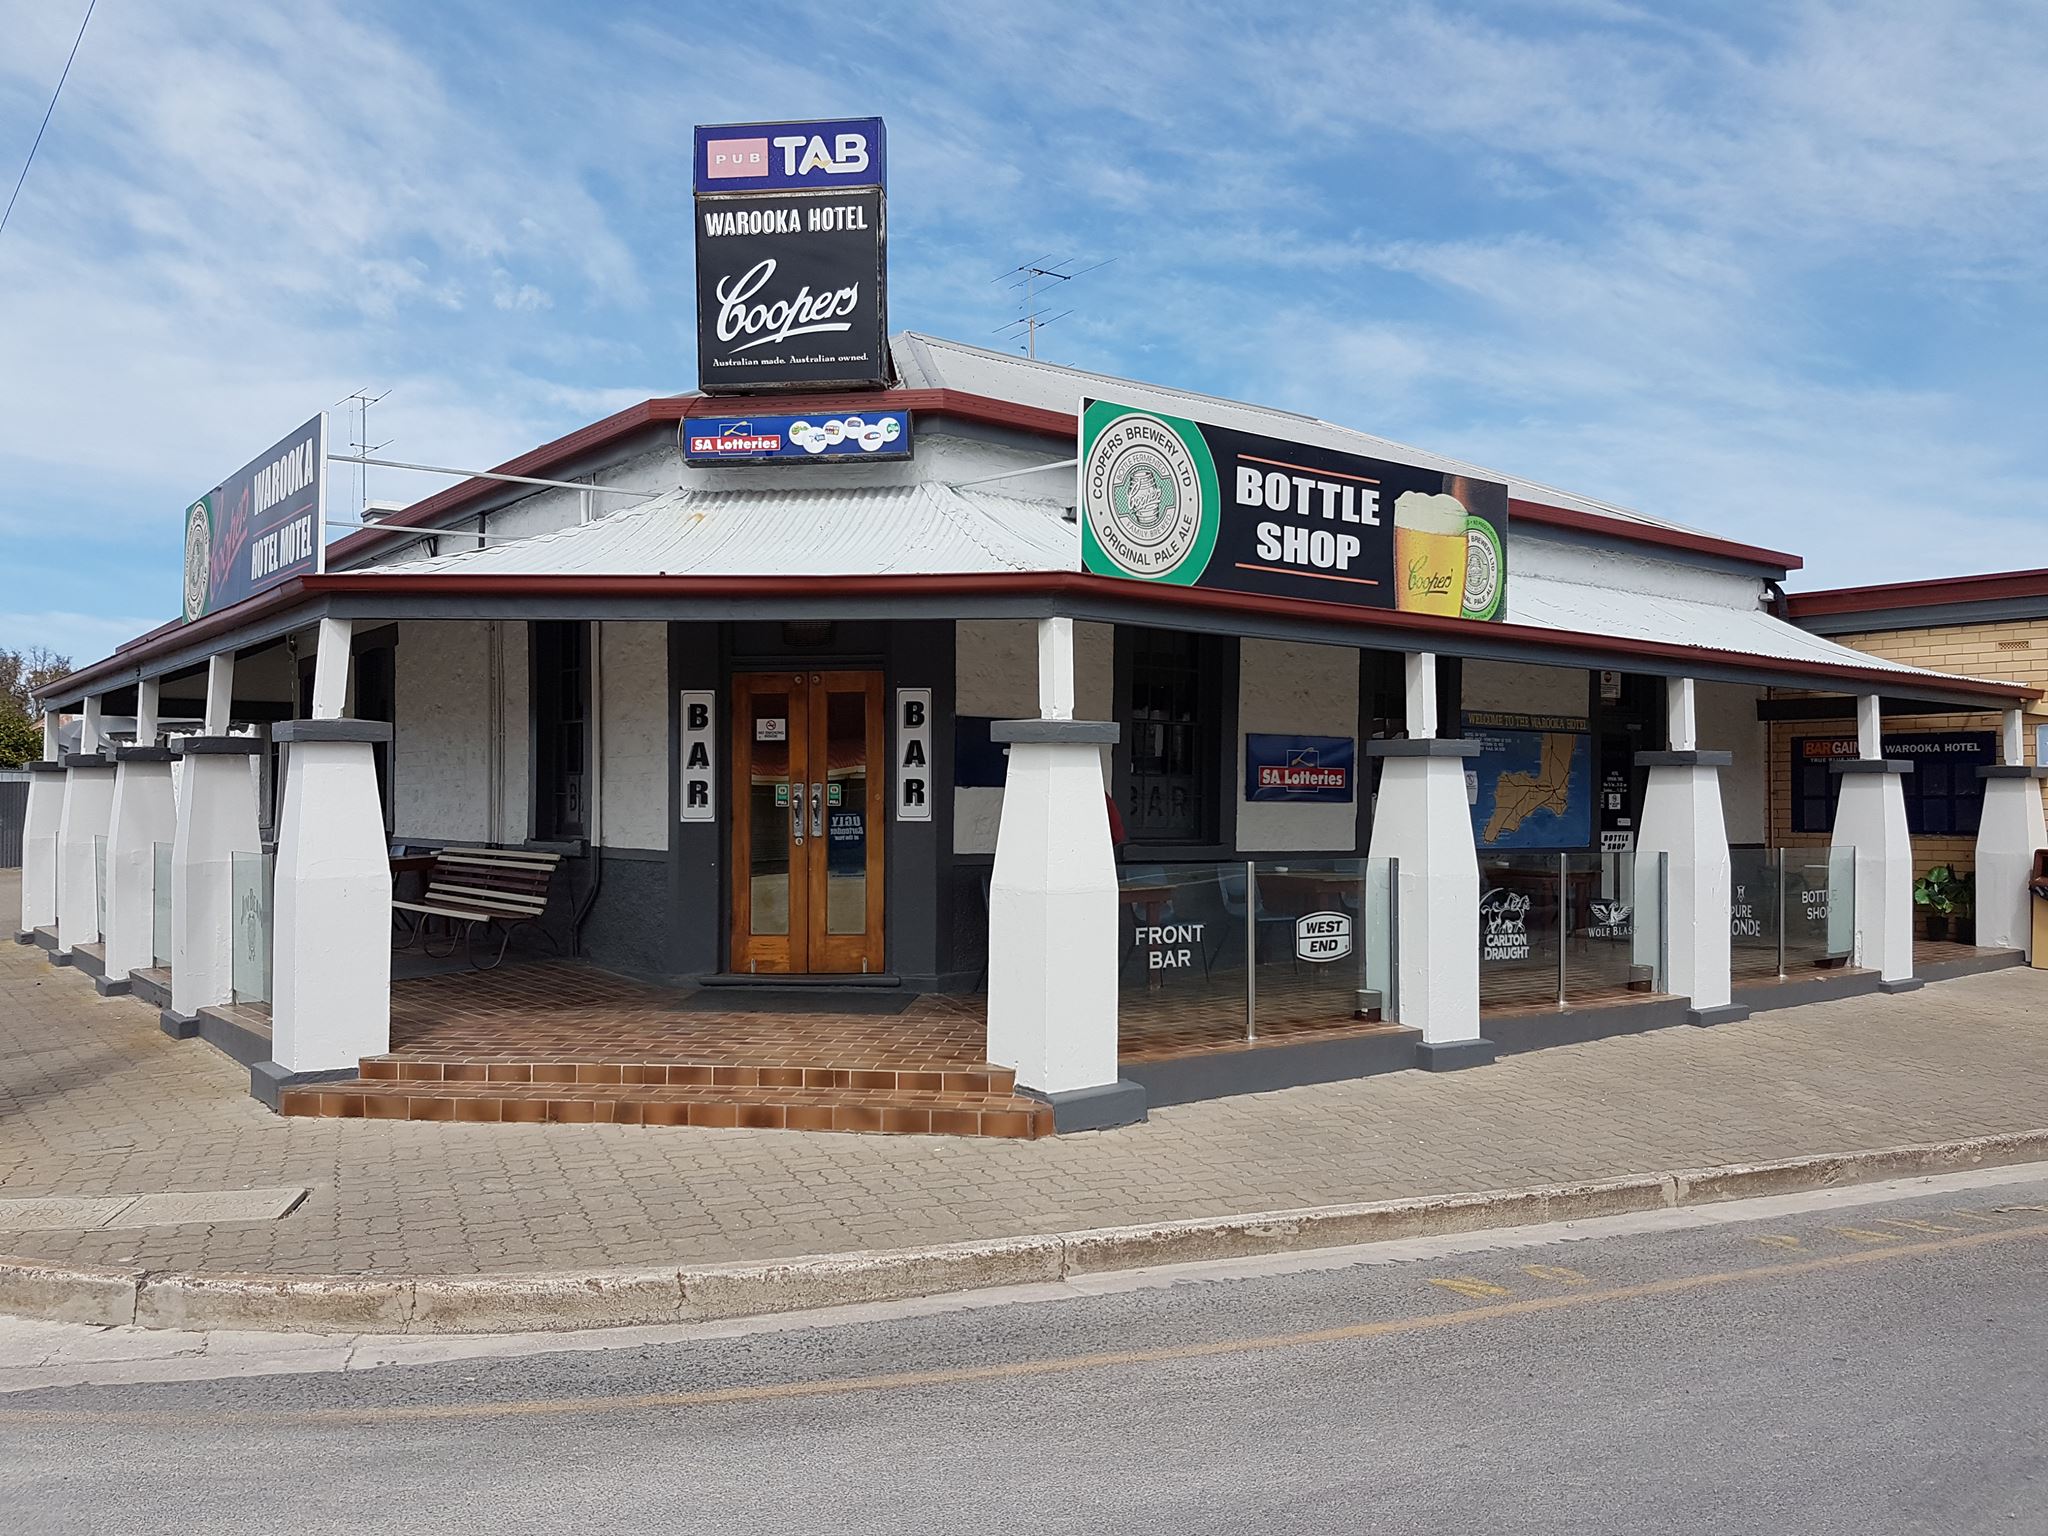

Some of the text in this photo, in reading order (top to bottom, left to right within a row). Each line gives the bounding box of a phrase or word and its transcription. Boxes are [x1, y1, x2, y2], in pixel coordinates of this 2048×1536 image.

[715, 152, 761, 165] PUB
[773, 133, 869, 176] TAB
[704, 206, 868, 237] WAROOKA HOTEL
[716, 258, 859, 345] Coopers
[712, 352, 869, 367] Australian made. Australian owned.
[694, 436, 779, 452] SA Lotteries
[1092, 426, 1192, 500] COOPERS BREWERY LTD
[253, 437, 314, 516] WAROOKA
[1236, 465, 1381, 527] BOTTLE
[251, 531, 278, 581] HOTEL
[279, 514, 313, 568] MOTEL
[1103, 514, 1193, 566] ORIGINAL PALE ALE
[1256, 521, 1361, 571] SHOP
[1504, 715, 1514, 727] TO
[686, 703, 711, 809] BAR
[902, 700, 926, 807] BAR
[1885, 742, 1981, 754] WAROOKA HOTEL
[1261, 768, 1344, 787] SA Lotteries
[1603, 834, 1629, 842] BOTTLE
[1135, 924, 1205, 946] FRONT
[1305, 920, 1343, 935] WEST
[1588, 927, 1611, 938] WOLF
[1731, 918, 1761, 937] ONDE
[1309, 939, 1338, 953] END
[1486, 933, 1527, 947] CARLTON
[1148, 949, 1192, 971] BAR
[1484, 946, 1530, 960] DRAUGHT
